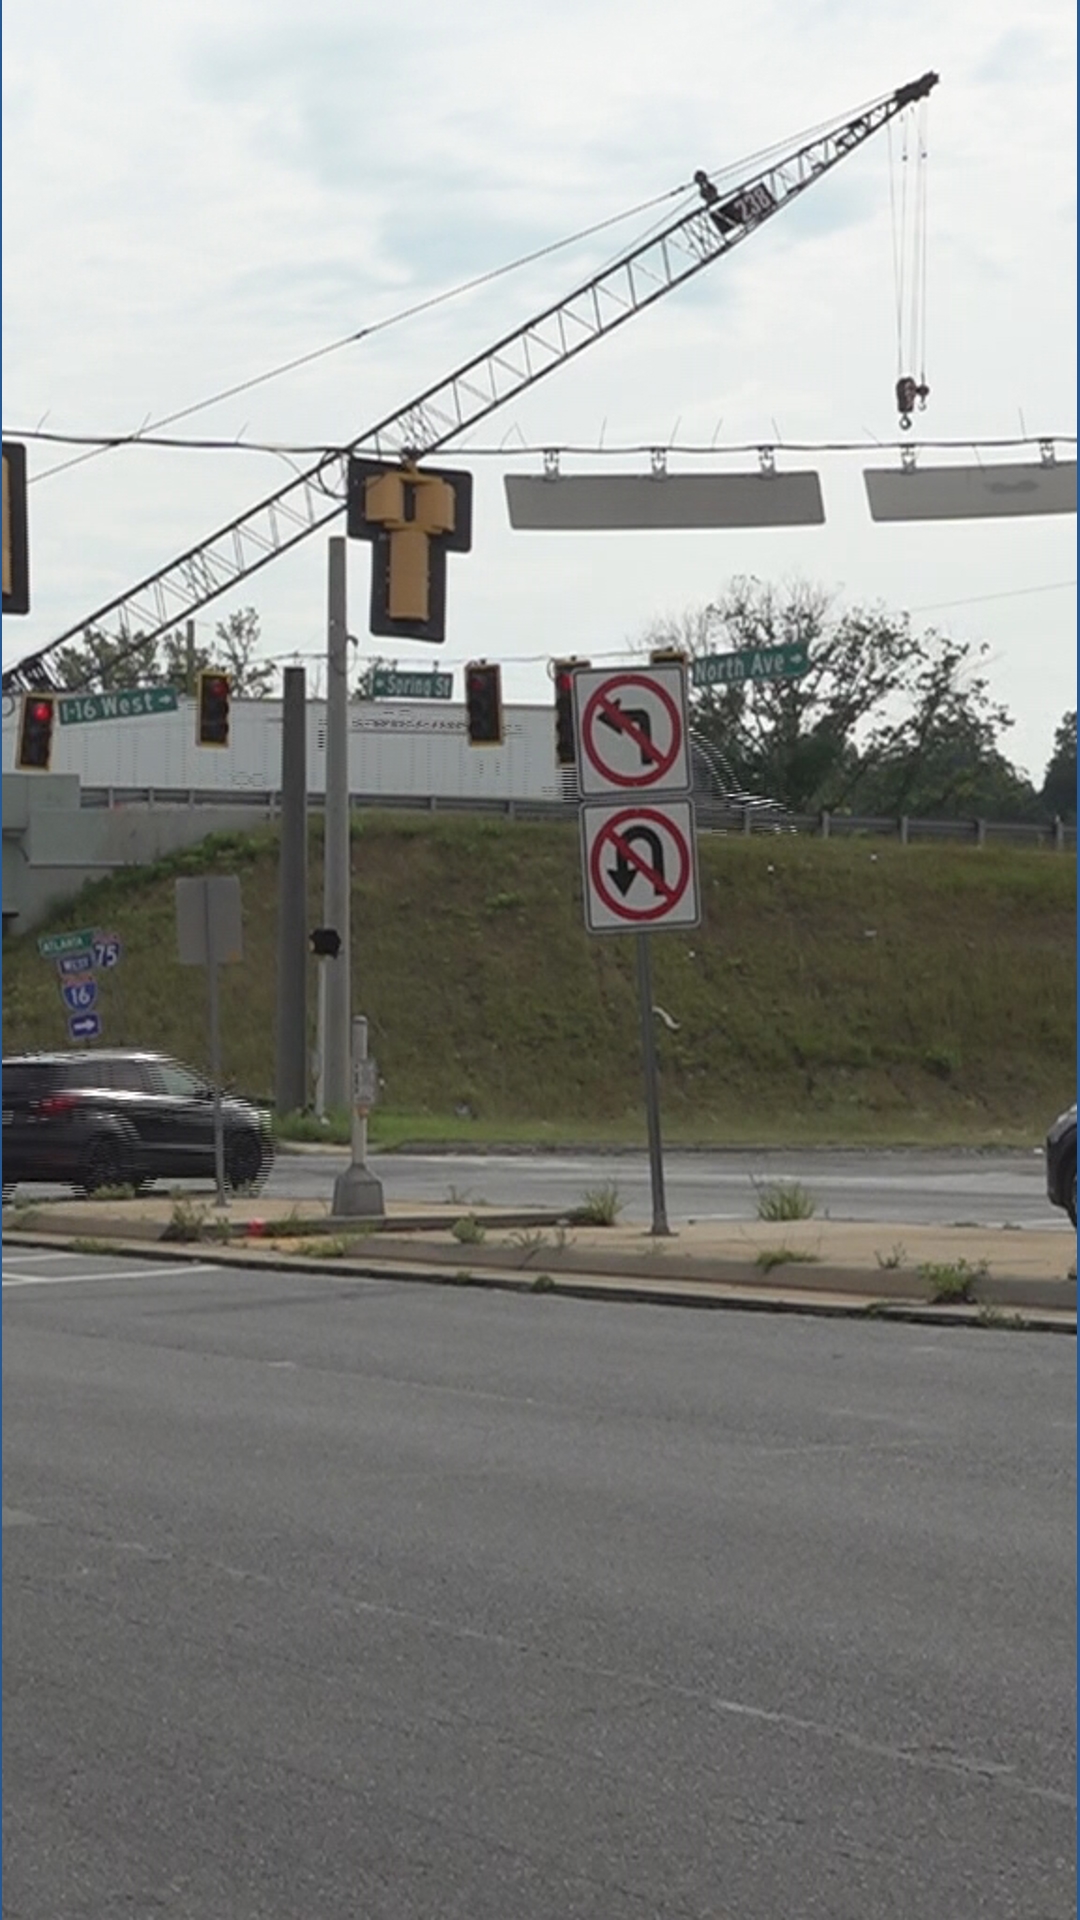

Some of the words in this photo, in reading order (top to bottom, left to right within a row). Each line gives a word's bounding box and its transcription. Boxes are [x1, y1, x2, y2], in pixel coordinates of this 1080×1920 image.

[734, 187, 771, 221] 238
[694, 657, 744, 683] North
[750, 653, 784, 674] Ave
[386, 674, 431, 696] Spring
[435, 676, 451, 695] St
[61, 700, 96, 722] I-16
[102, 693, 153, 716] West
[43, 935, 84, 952] ATLANTA
[95, 944, 118, 966] 75
[71, 986, 91, 1005] 16
